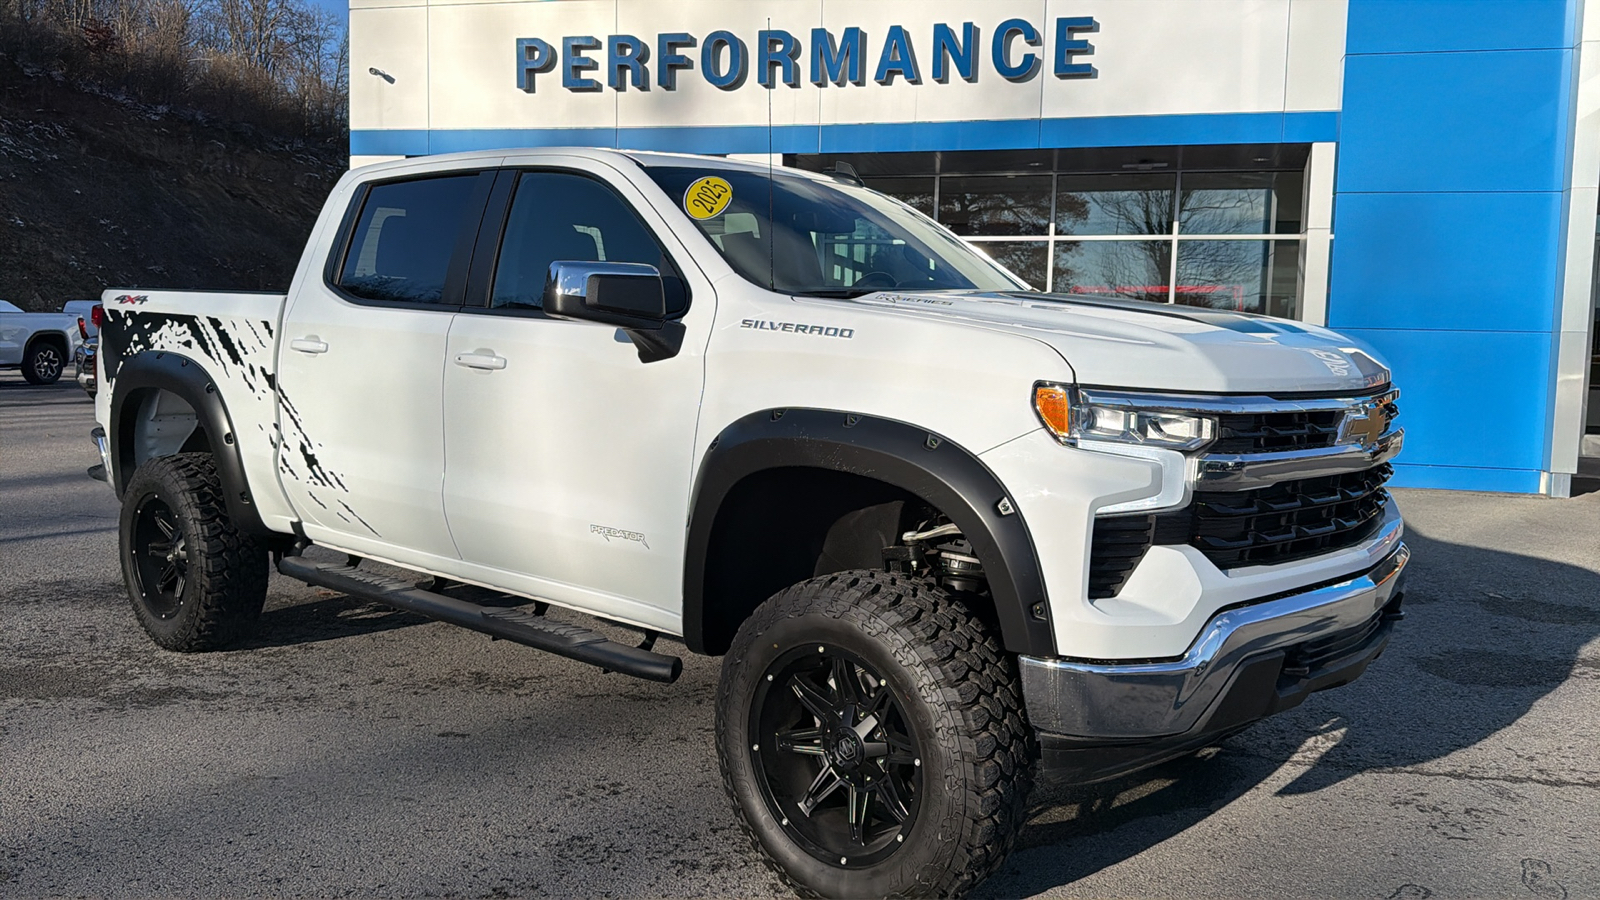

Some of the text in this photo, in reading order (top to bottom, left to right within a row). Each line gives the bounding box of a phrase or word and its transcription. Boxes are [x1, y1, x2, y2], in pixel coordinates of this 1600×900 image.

[516, 16, 1100, 93] PERFORMANCE
[692, 179, 728, 213] 2025
[740, 318, 855, 339] SILVERADO
[590, 524, 650, 550] PREDATOR
